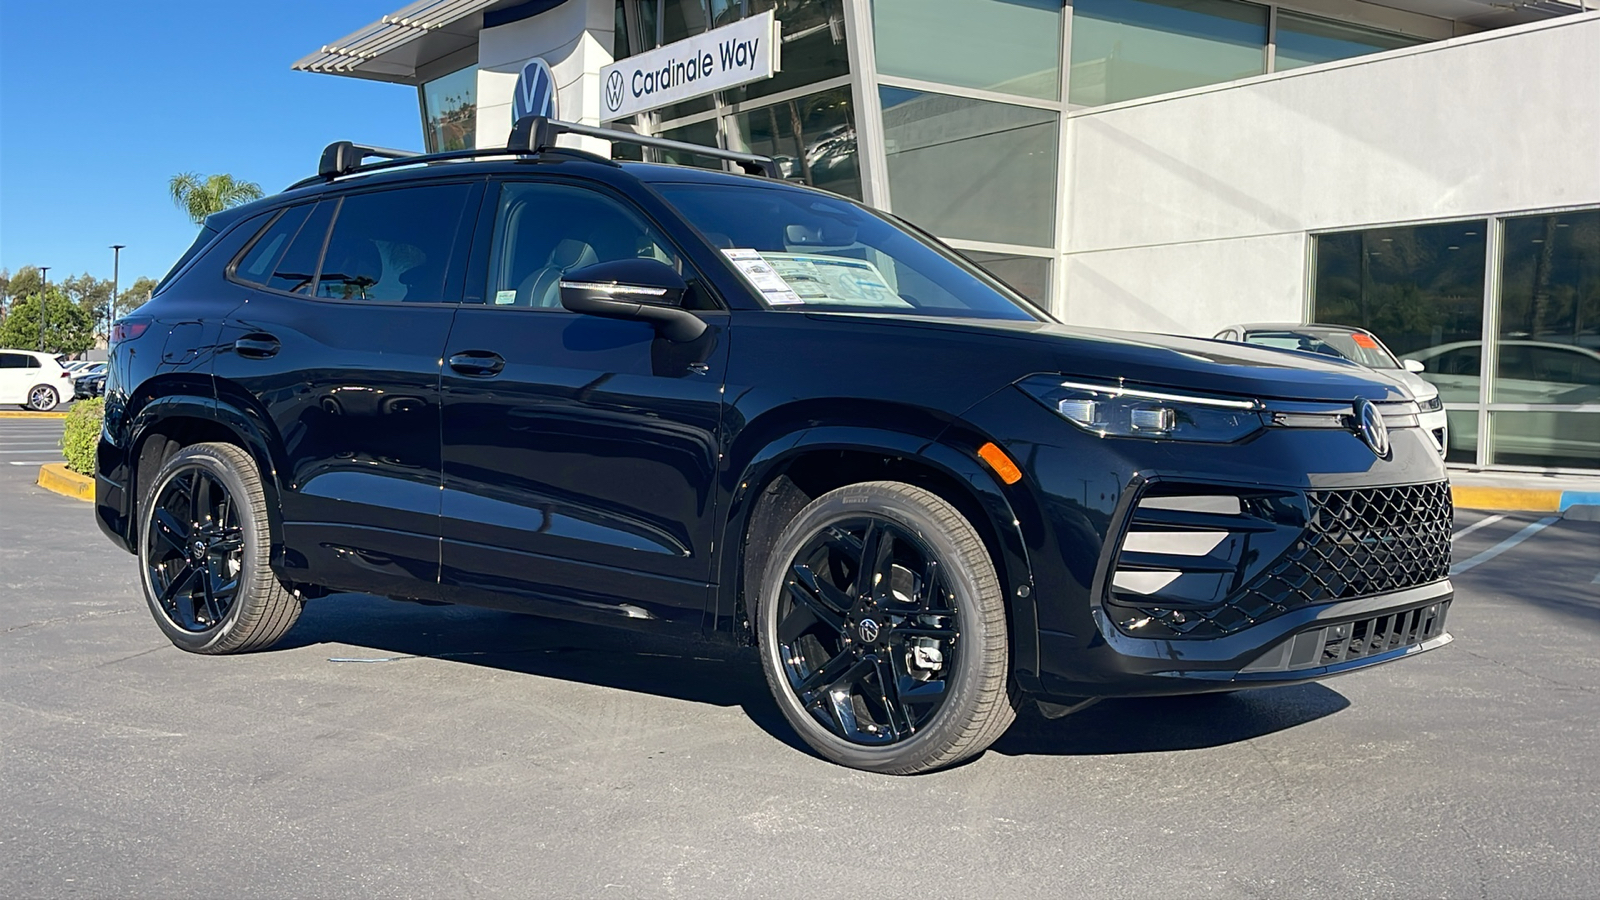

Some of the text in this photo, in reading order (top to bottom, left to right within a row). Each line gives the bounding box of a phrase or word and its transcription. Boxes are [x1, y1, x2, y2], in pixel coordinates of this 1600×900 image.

[606, 37, 759, 112] VW Cardinale Way
